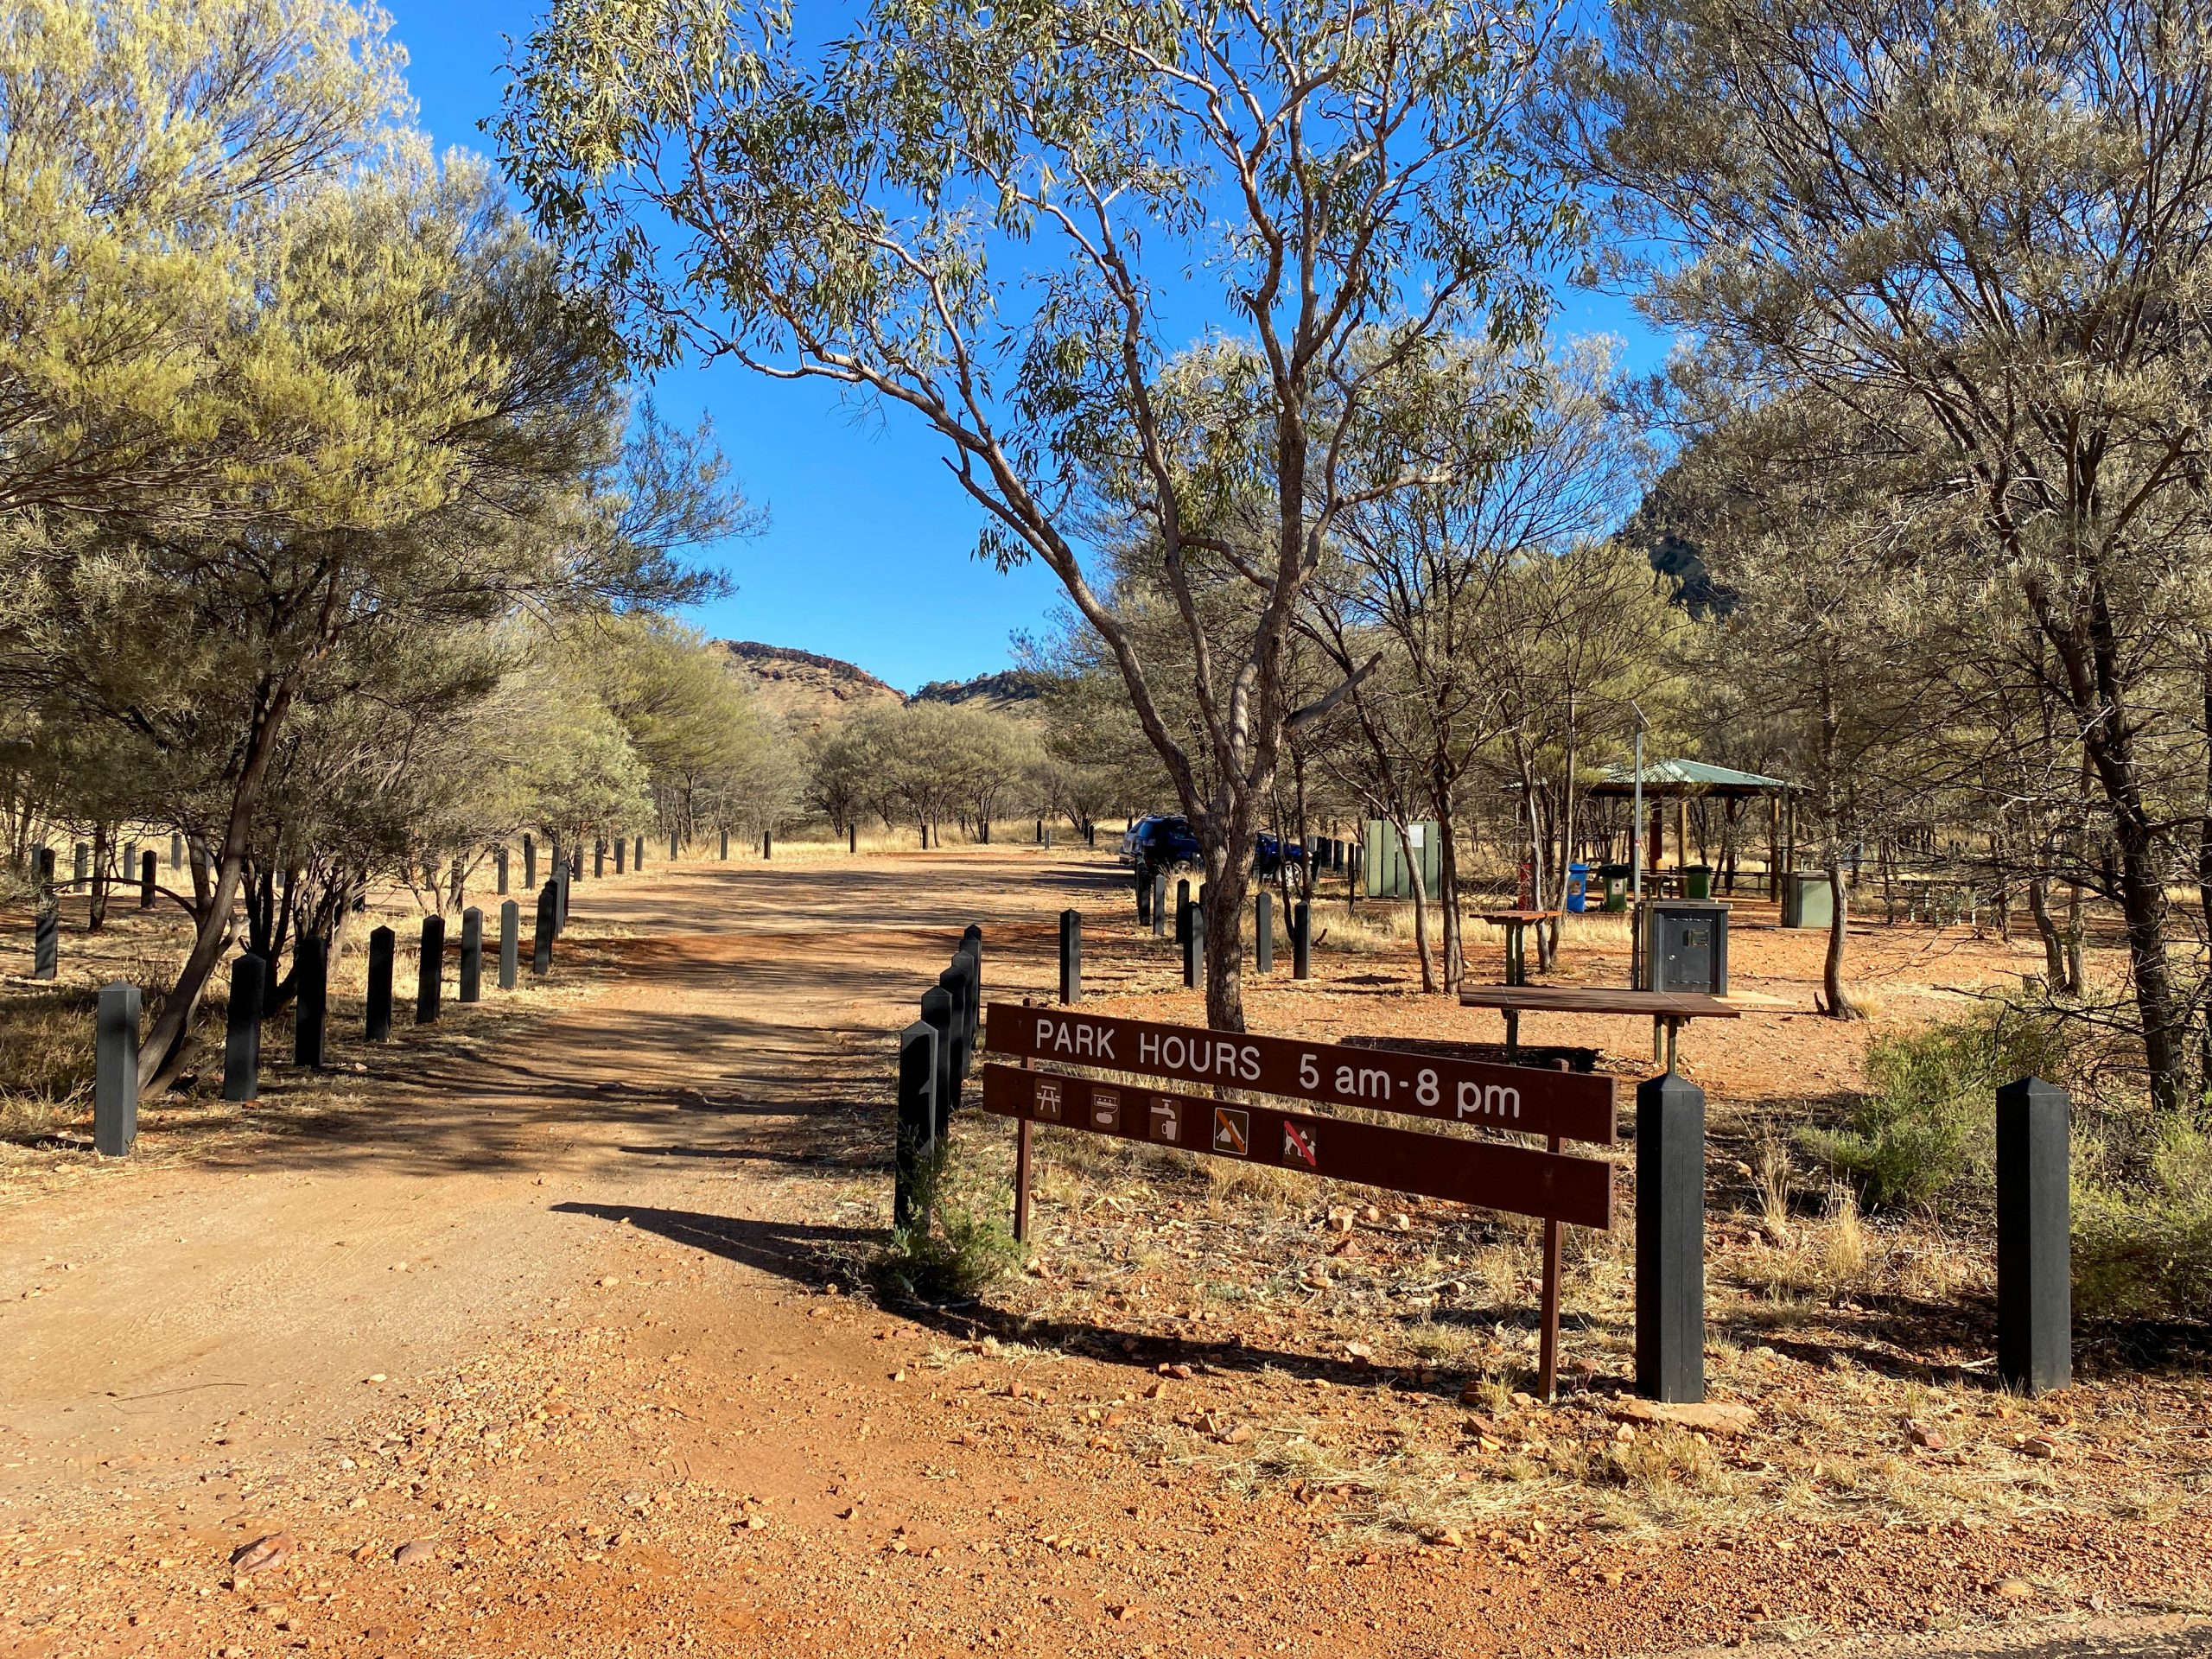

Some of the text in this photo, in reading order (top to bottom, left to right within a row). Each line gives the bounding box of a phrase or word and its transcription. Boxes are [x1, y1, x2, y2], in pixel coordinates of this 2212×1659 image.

[1035, 1018, 1116, 1060] PARK
[1139, 1031, 1262, 1081] HOURS
[1298, 1052, 1320, 1090] 5
[1456, 1080, 1521, 1119] pm
